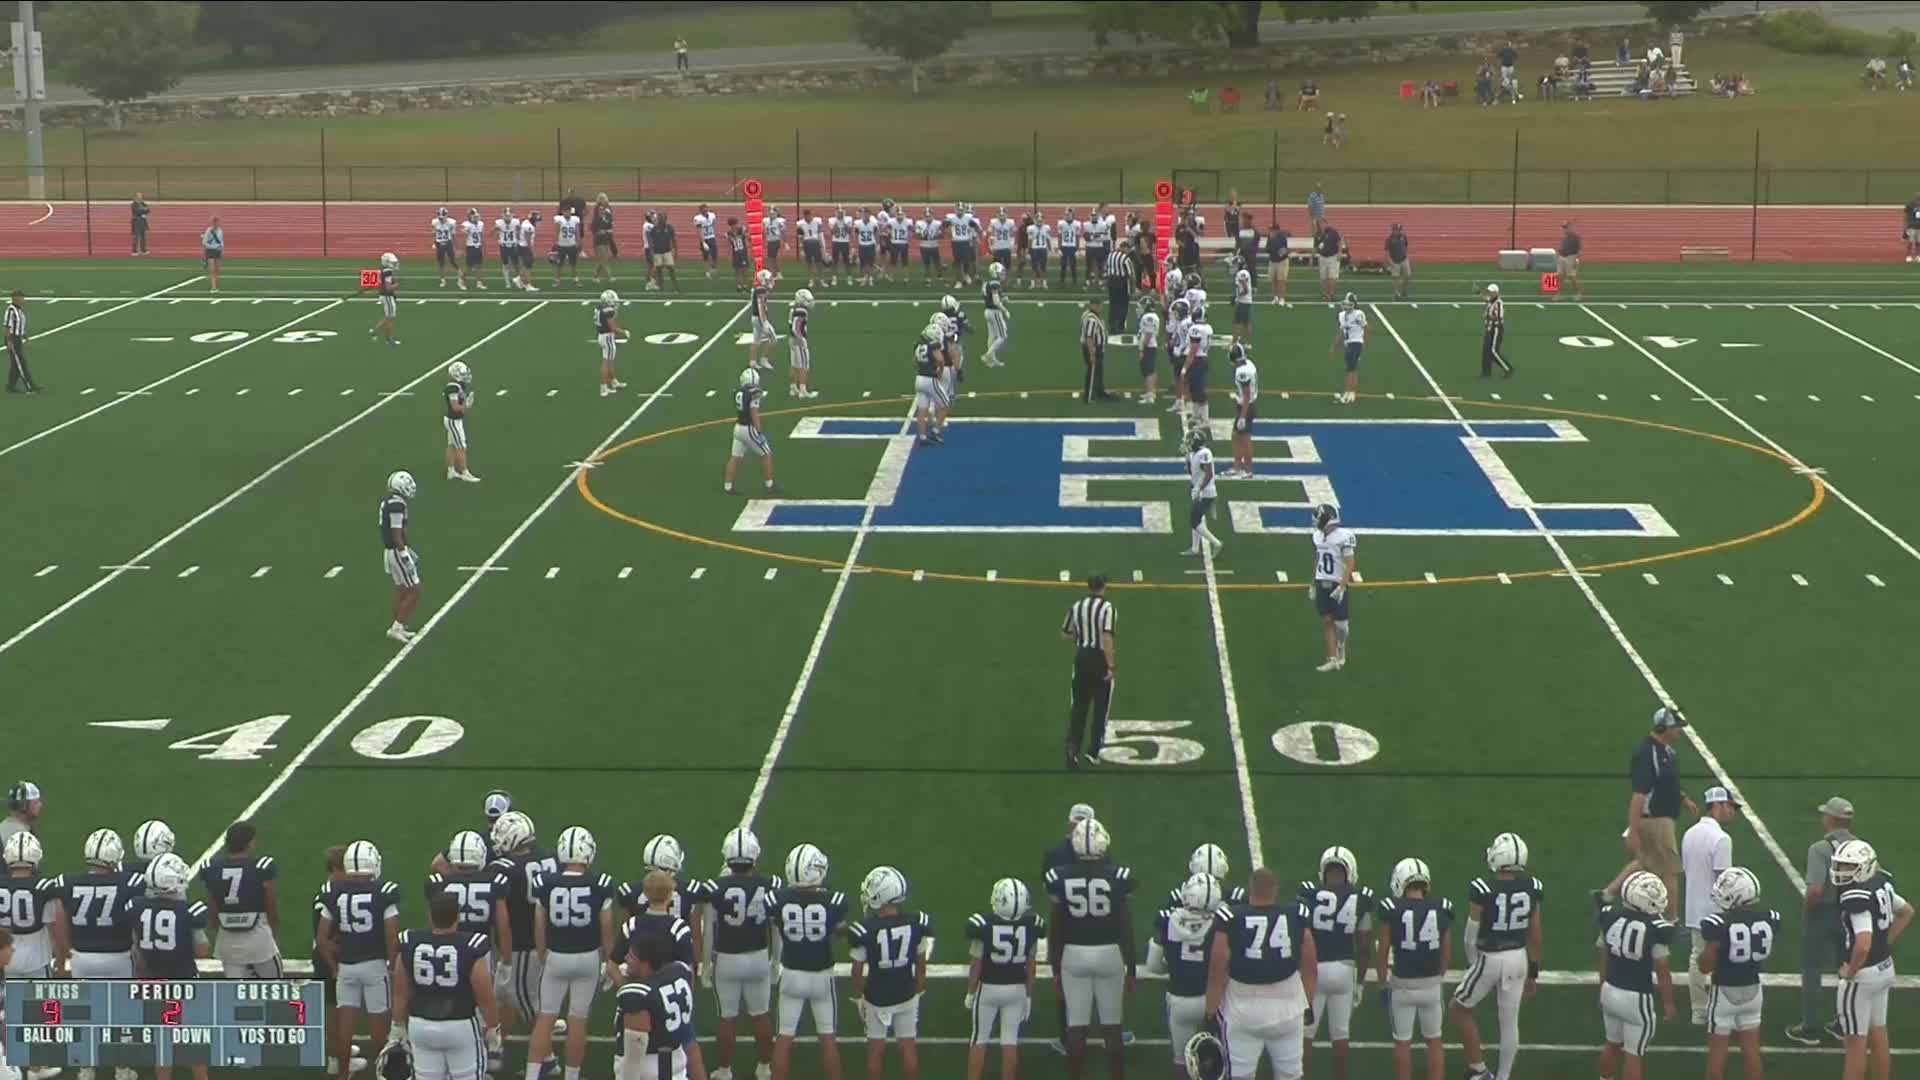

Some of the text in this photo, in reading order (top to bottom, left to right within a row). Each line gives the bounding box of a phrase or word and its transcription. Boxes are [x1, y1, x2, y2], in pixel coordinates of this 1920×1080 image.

[362, 272, 378, 285] 30
[1543, 275, 1559, 289] 40
[72, 885, 118, 926] 77
[221, 868, 243, 904] 7
[550, 886, 592, 927] 85
[724, 887, 766, 926] 34
[1064, 878, 1112, 918] 56
[0, 888, 35, 928] 20
[336, 893, 374, 933] 15
[782, 903, 827, 942] 88
[1312, 890, 1358, 934] 24
[1490, 891, 1531, 931] 12
[140, 908, 177, 950] 19
[876, 925, 912, 969] 17
[990, 924, 1027, 963] 51
[1244, 914, 1292, 960] 74
[1401, 909, 1440, 950] 14
[1605, 918, 1647, 960] 40
[1728, 920, 1774, 963] 83
[413, 943, 459, 987] 63
[658, 978, 694, 1032] 53
